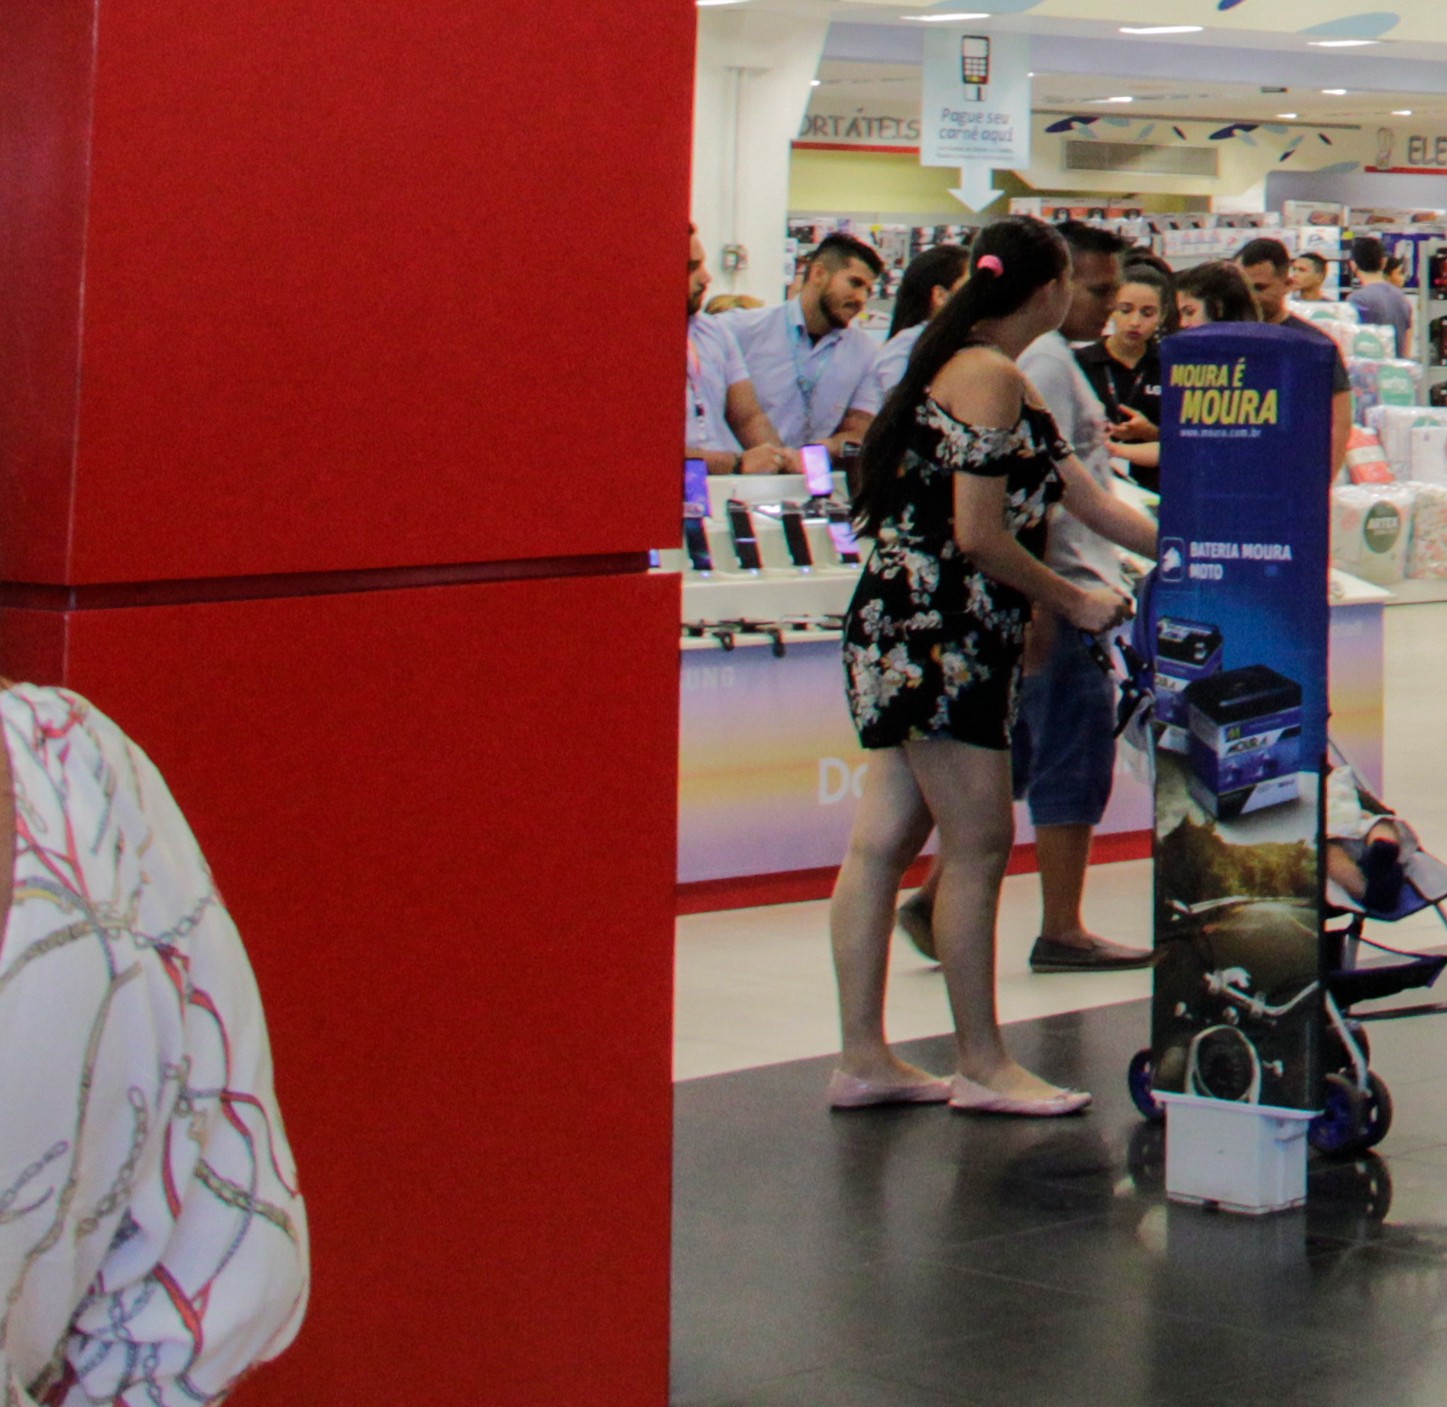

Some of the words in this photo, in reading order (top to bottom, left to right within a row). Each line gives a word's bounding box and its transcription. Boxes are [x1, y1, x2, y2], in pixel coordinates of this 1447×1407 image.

[941, 108, 985, 128] Pague
[986, 111, 1010, 125] seu
[980, 127, 1014, 145] aqui
[1169, 364, 1230, 388] MOURA
[1231, 357, 1246, 388] É
[1179, 389, 1279, 426] MOURA
[1189, 541, 1240, 559] BATERIA
[1241, 543, 1293, 561] MOURA
